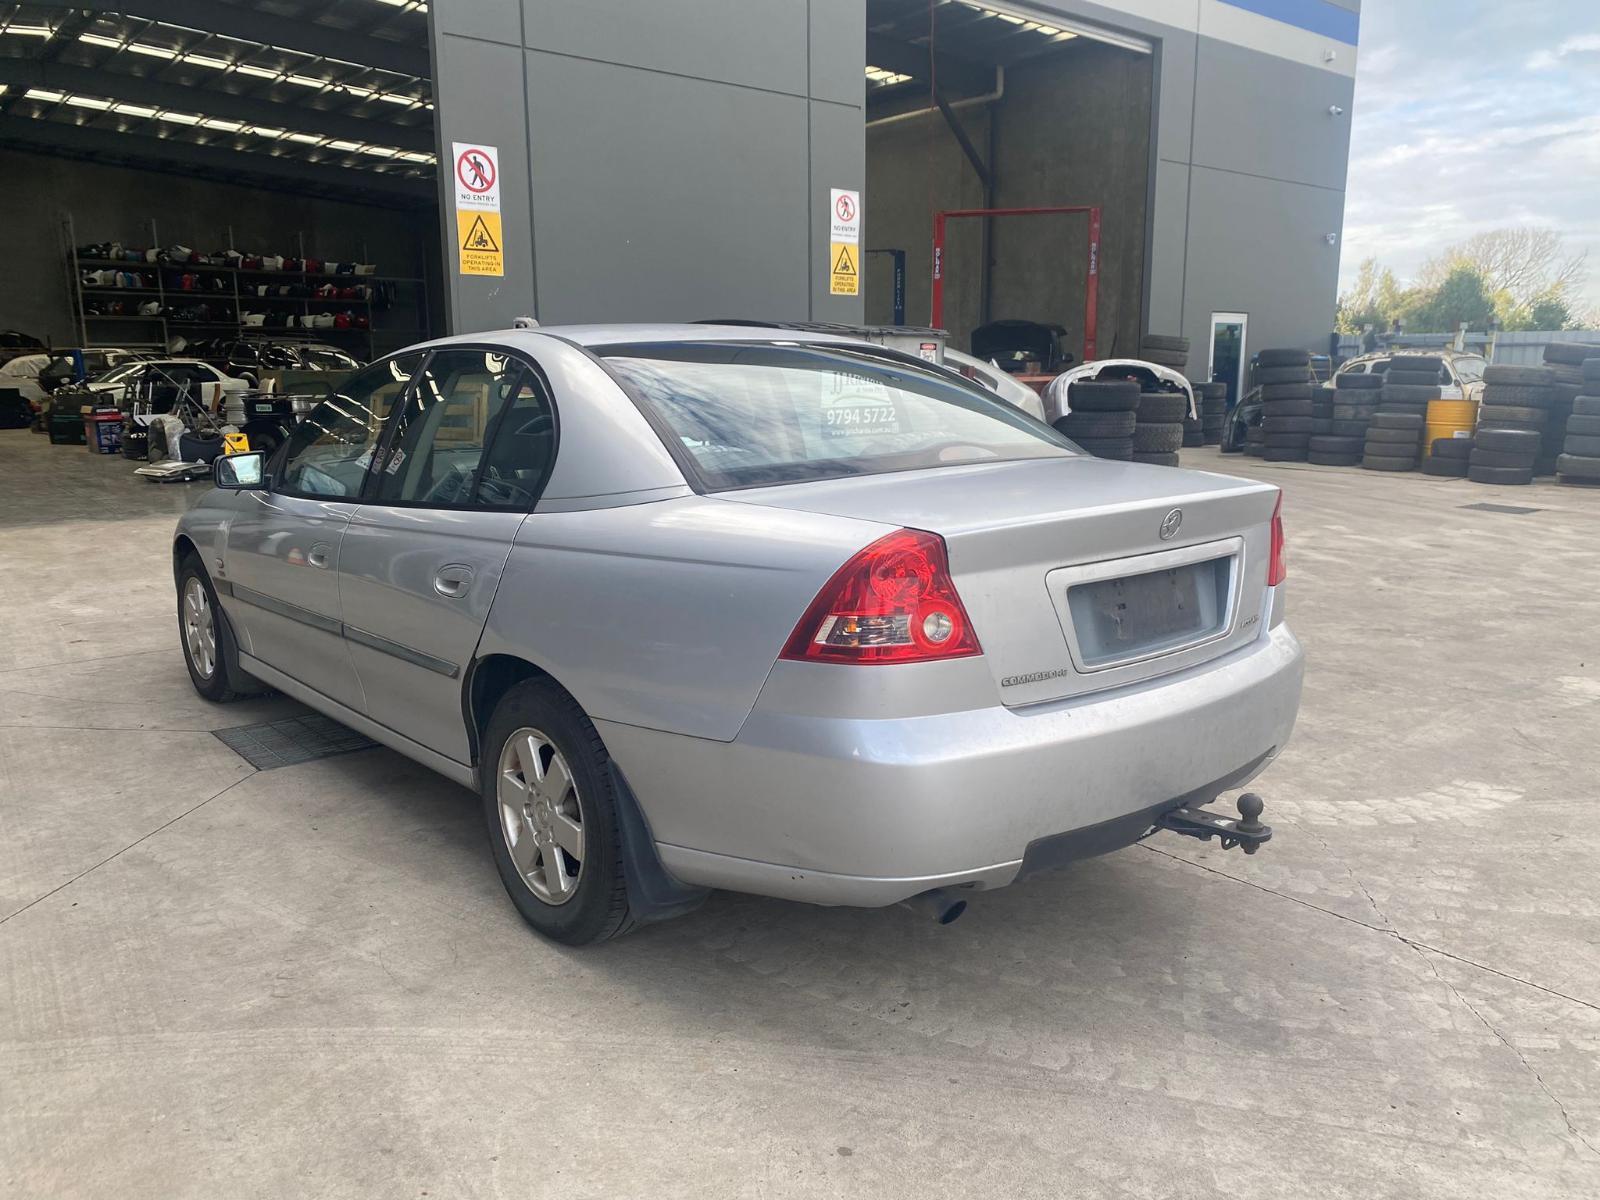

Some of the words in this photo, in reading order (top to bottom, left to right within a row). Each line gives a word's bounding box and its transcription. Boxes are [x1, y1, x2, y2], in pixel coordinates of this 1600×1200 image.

[827, 408, 860, 425] 9794
[863, 407, 896, 424] 5722
[1001, 669, 1068, 687] COMMODORE
